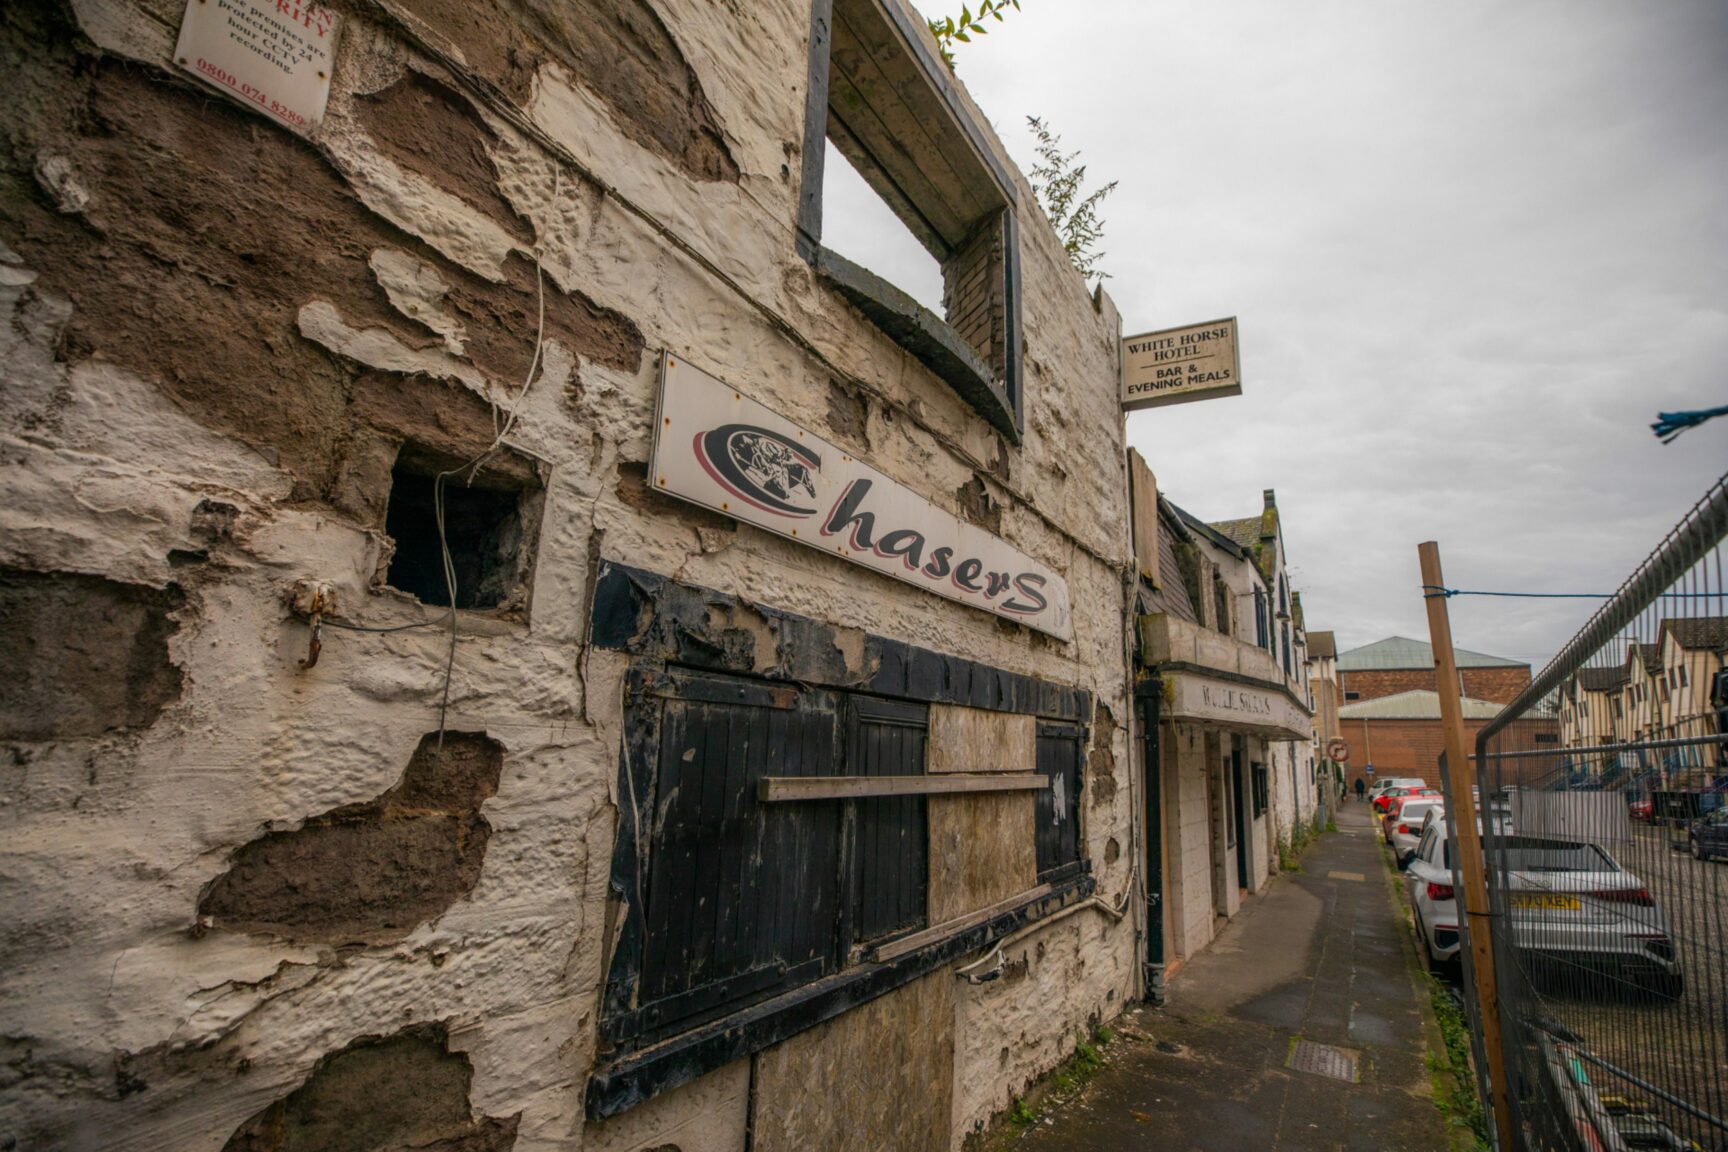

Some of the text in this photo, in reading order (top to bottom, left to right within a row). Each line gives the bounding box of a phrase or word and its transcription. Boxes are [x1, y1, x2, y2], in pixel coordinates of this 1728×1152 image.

[217, 0, 313, 62] protected by 24
[227, 16, 300, 65] hour CCTV
[250, 7, 303, 45] premises
[306, 43, 326, 58] are
[196, 57, 305, 125] 0800 074 8289
[1128, 327, 1229, 355] WHITE HORSE
[1154, 344, 1201, 362] HOTEL
[1128, 368, 1230, 395] EVENING MEALS
[1156, 364, 1198, 379] BAR &
